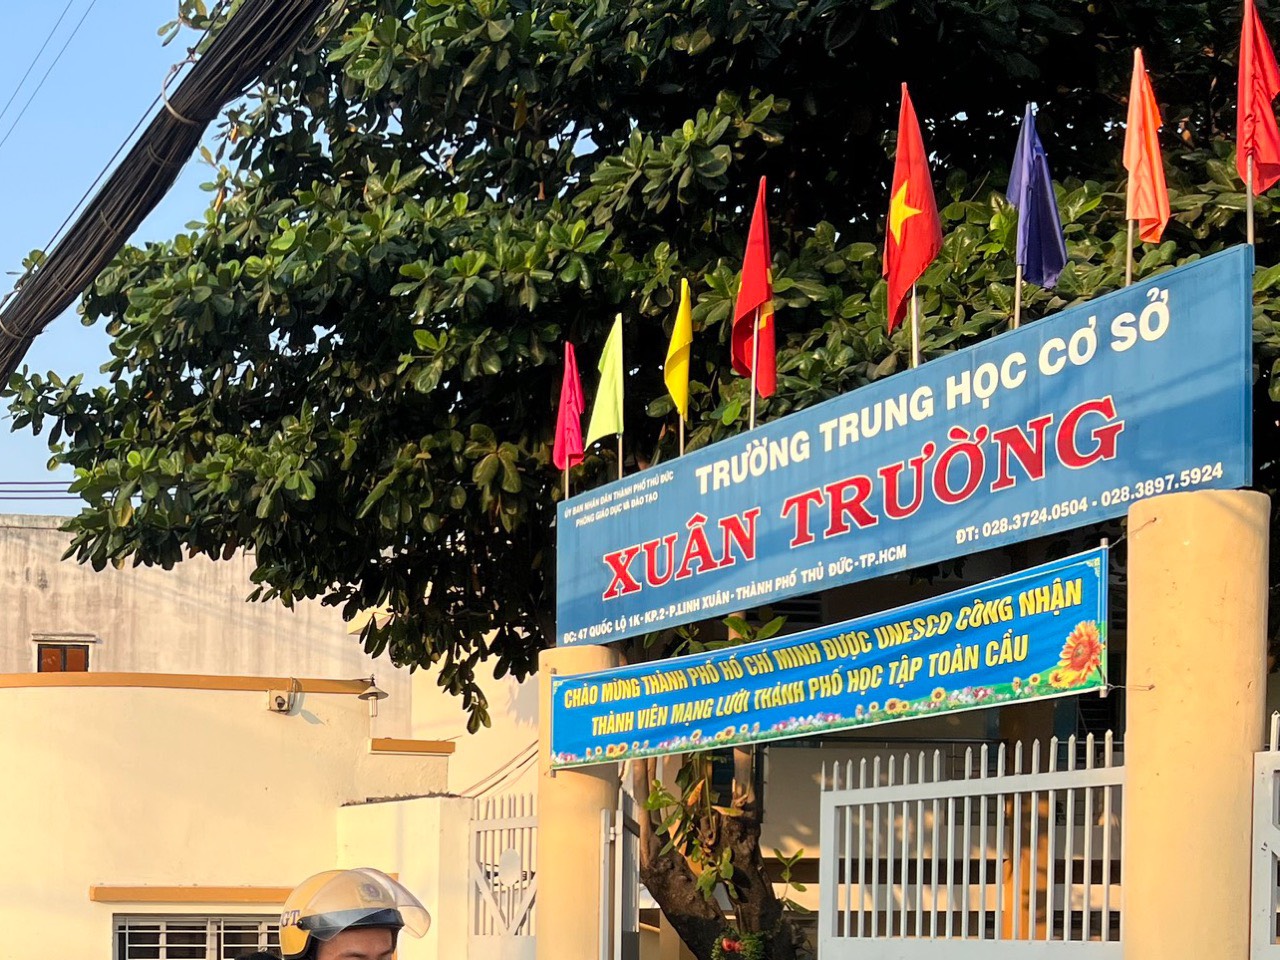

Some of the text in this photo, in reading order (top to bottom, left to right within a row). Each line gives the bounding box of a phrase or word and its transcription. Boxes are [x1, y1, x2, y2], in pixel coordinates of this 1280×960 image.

[695, 287, 1170, 495] TRƯỜNG TRUNG HỌC CƠ SỞ
[602, 394, 1125, 602] XUÂN TRƯỜNG
[955, 525, 980, 545] ĐT:
[982, 497, 1088, 538] 028.3724.0504
[1101, 462, 1223, 507] 028.3897.5924
[564, 683, 598, 709] CHÀO
[641, 669, 688, 695] THÀNH
[689, 656, 720, 687] PHỐ
[720, 652, 744, 681] HỒ
[744, 648, 774, 677] CHÍ
[772, 642, 821, 670] MINH
[821, 630, 872, 661] ĐƯỢC
[873, 611, 952, 649] UNESCO
[954, 595, 1014, 630] CÔNG
[1018, 577, 1083, 618] NHẬN
[578, 628, 588, 640] 47
[589, 618, 613, 638] QUỐC
[615, 615, 627, 633] LỘ
[775, 568, 797, 591] PHỐ
[801, 561, 824, 583] THỦ
[592, 628, 1029, 736] THÀNH VIÊN MẠNG LƯỚI THÀNH PHỐ HỌC TẬP TOÀN CẦU
